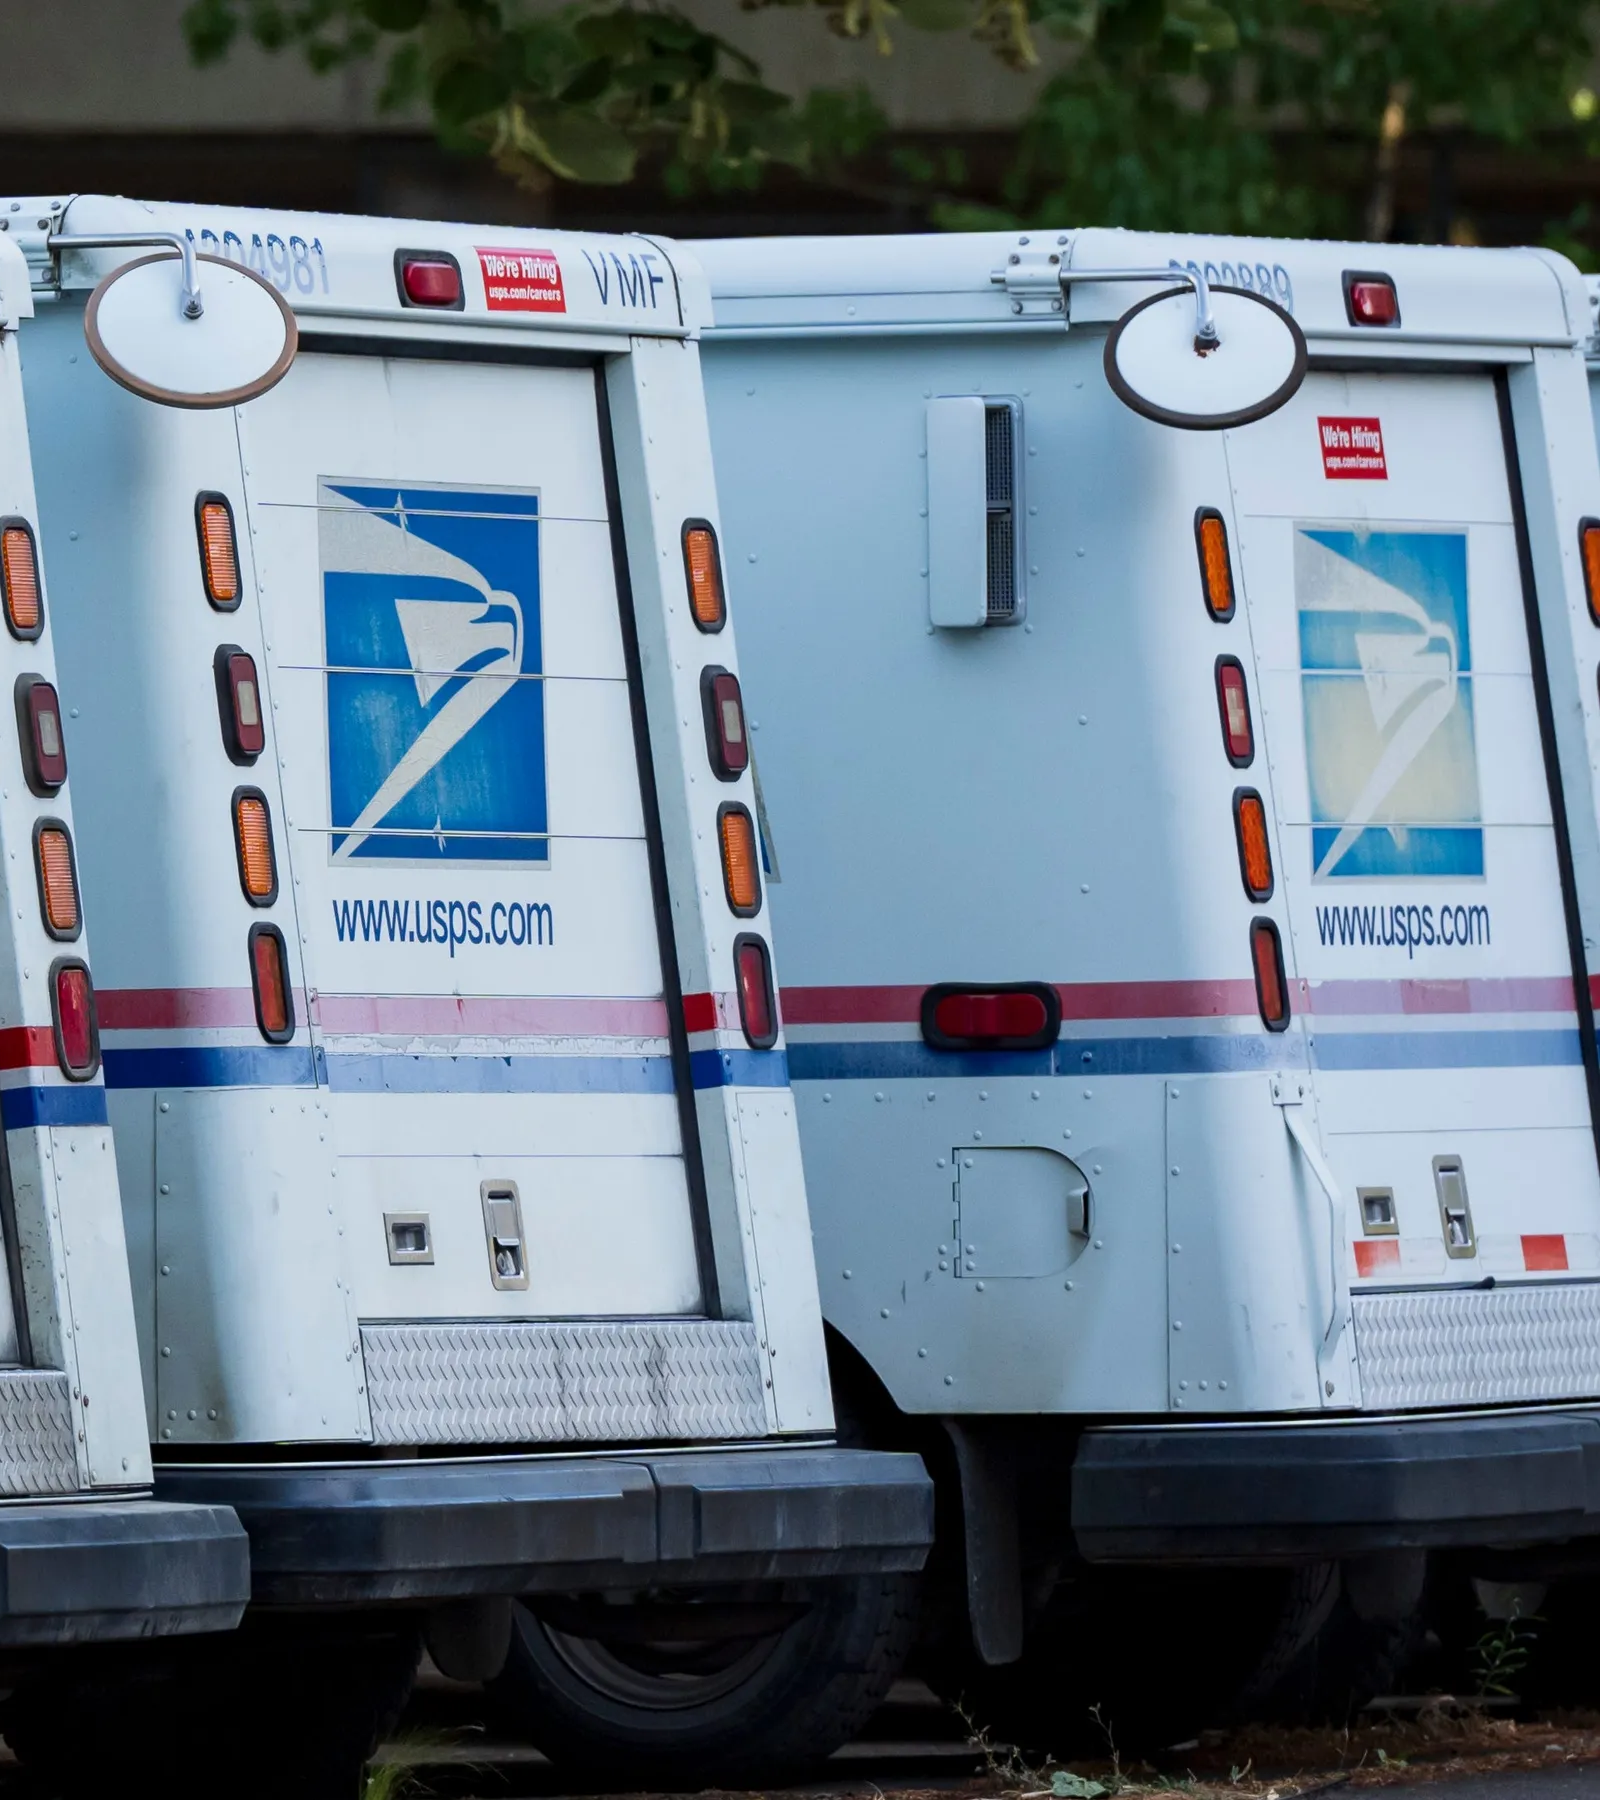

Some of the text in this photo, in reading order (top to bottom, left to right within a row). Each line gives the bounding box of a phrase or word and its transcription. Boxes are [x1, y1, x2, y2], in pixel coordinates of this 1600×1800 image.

[483, 255, 557, 284] We're Hiring
[581, 248, 663, 308] VMF
[489, 285, 561, 301] usps.com/careers
[1322, 425, 1380, 453] We're Hiring
[332, 899, 554, 958] www.usps.com
[1316, 905, 1491, 960] www.usps.com
